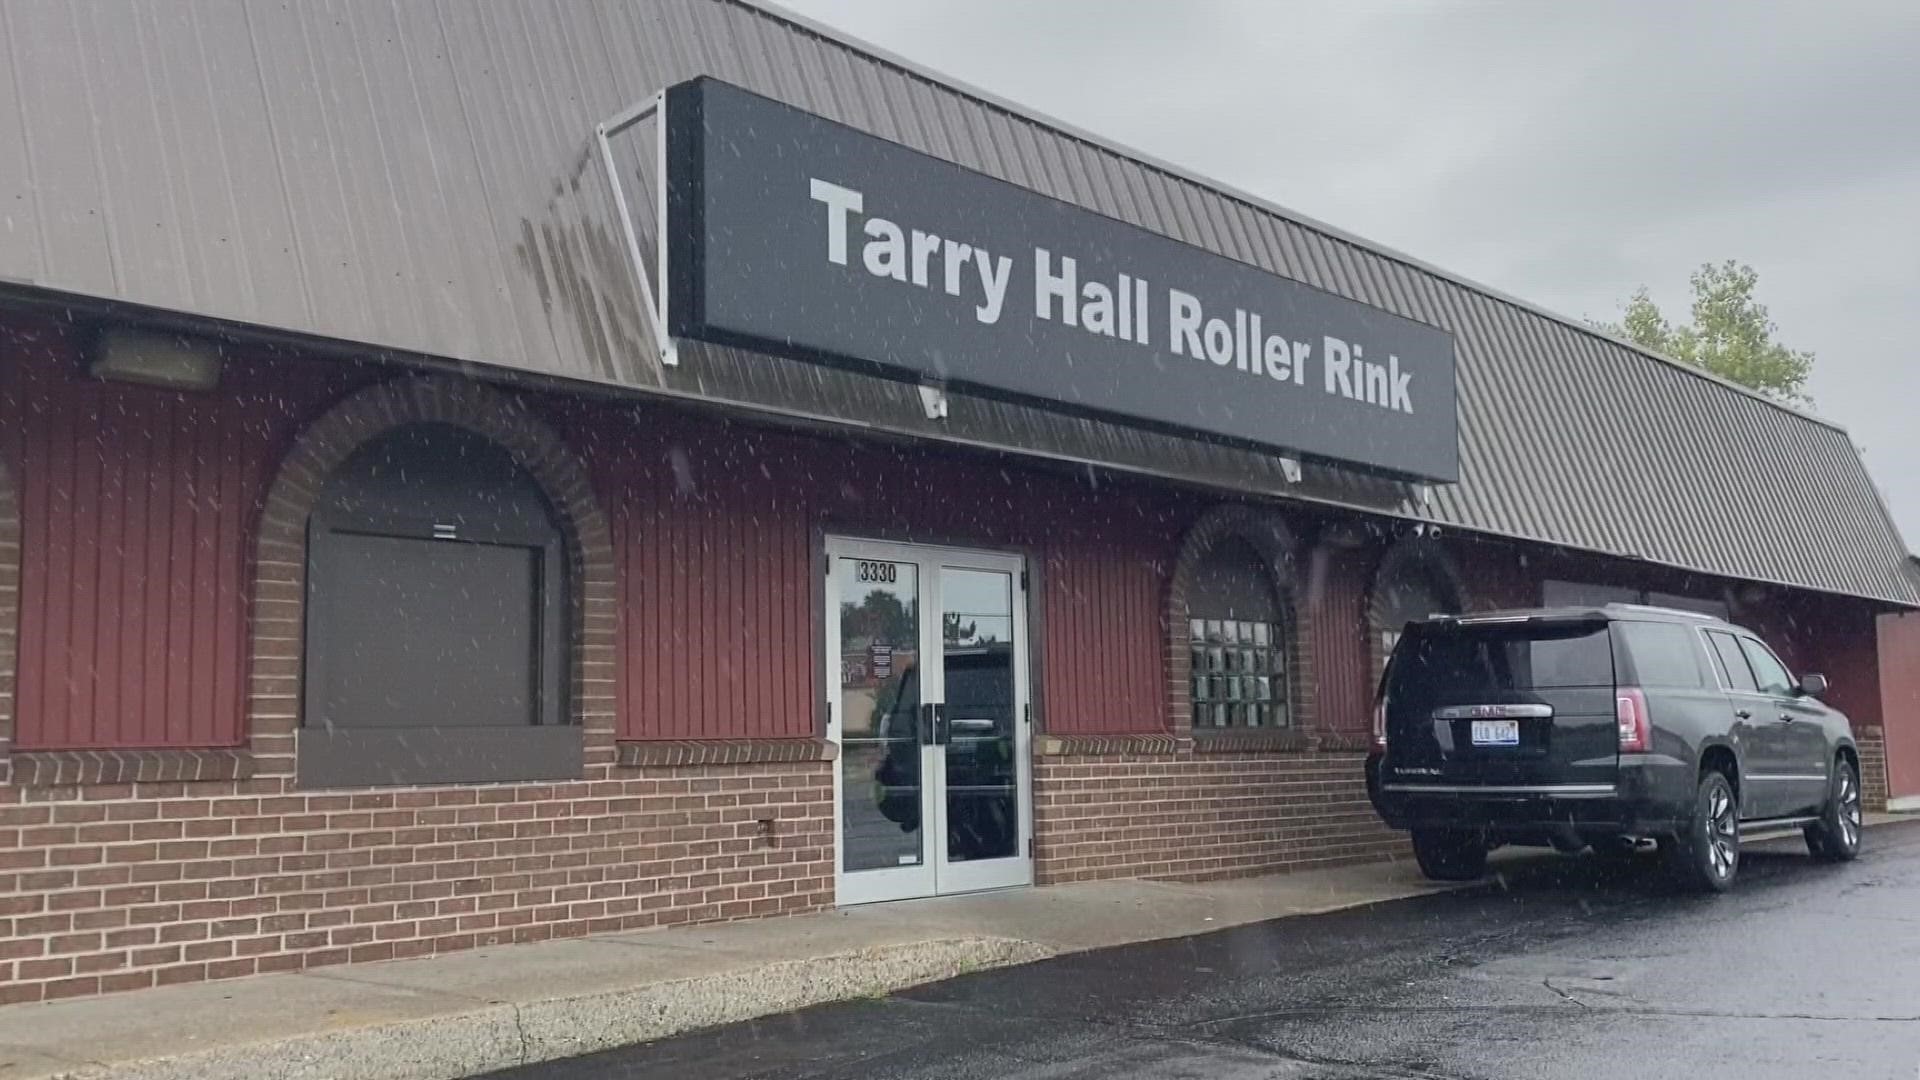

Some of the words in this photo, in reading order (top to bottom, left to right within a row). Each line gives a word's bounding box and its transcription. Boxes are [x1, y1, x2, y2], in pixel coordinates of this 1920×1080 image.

[810, 177, 1013, 324] Tarry
[1034, 246, 1149, 345] Hall
[1169, 287, 1312, 386] Roller
[1323, 335, 1414, 415] Rink
[860, 561, 896, 583] 3330
